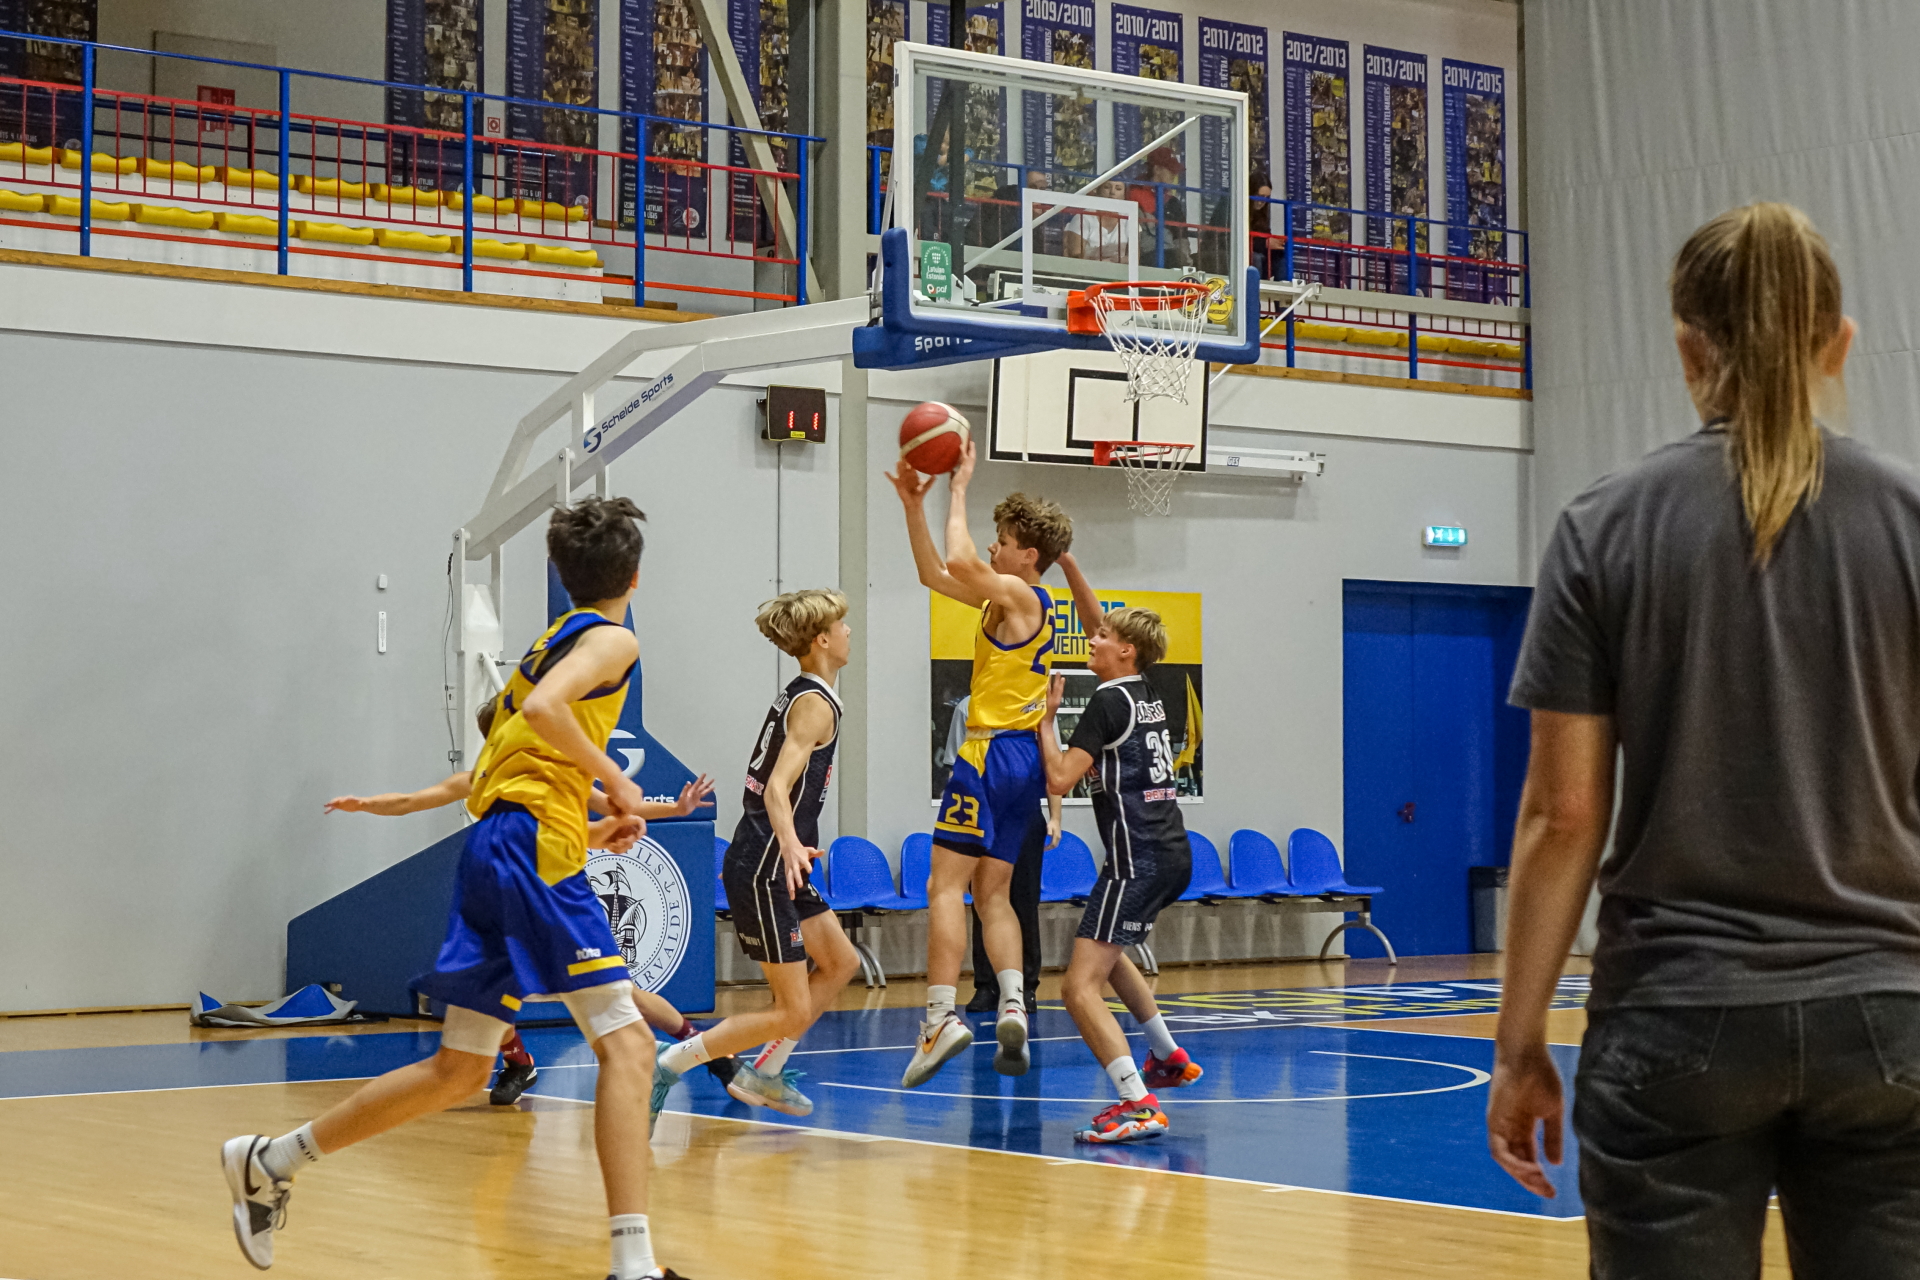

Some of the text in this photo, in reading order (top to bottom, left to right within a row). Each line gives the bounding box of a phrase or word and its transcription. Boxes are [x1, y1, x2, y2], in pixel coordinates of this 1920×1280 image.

[1026, 0, 1092, 27] 2009/2010
[1116, 13, 1179, 42] 2010/2011
[1203, 28, 1264, 55] 2011/2012
[1286, 42, 1347, 68] 2012/2013
[1366, 57, 1426, 82] 2013/2014
[1445, 69, 1502, 93] 2014/2015
[601, 397, 640, 434] Schelde
[640, 372, 674, 402] Sports
[944, 793, 980, 827] 23
